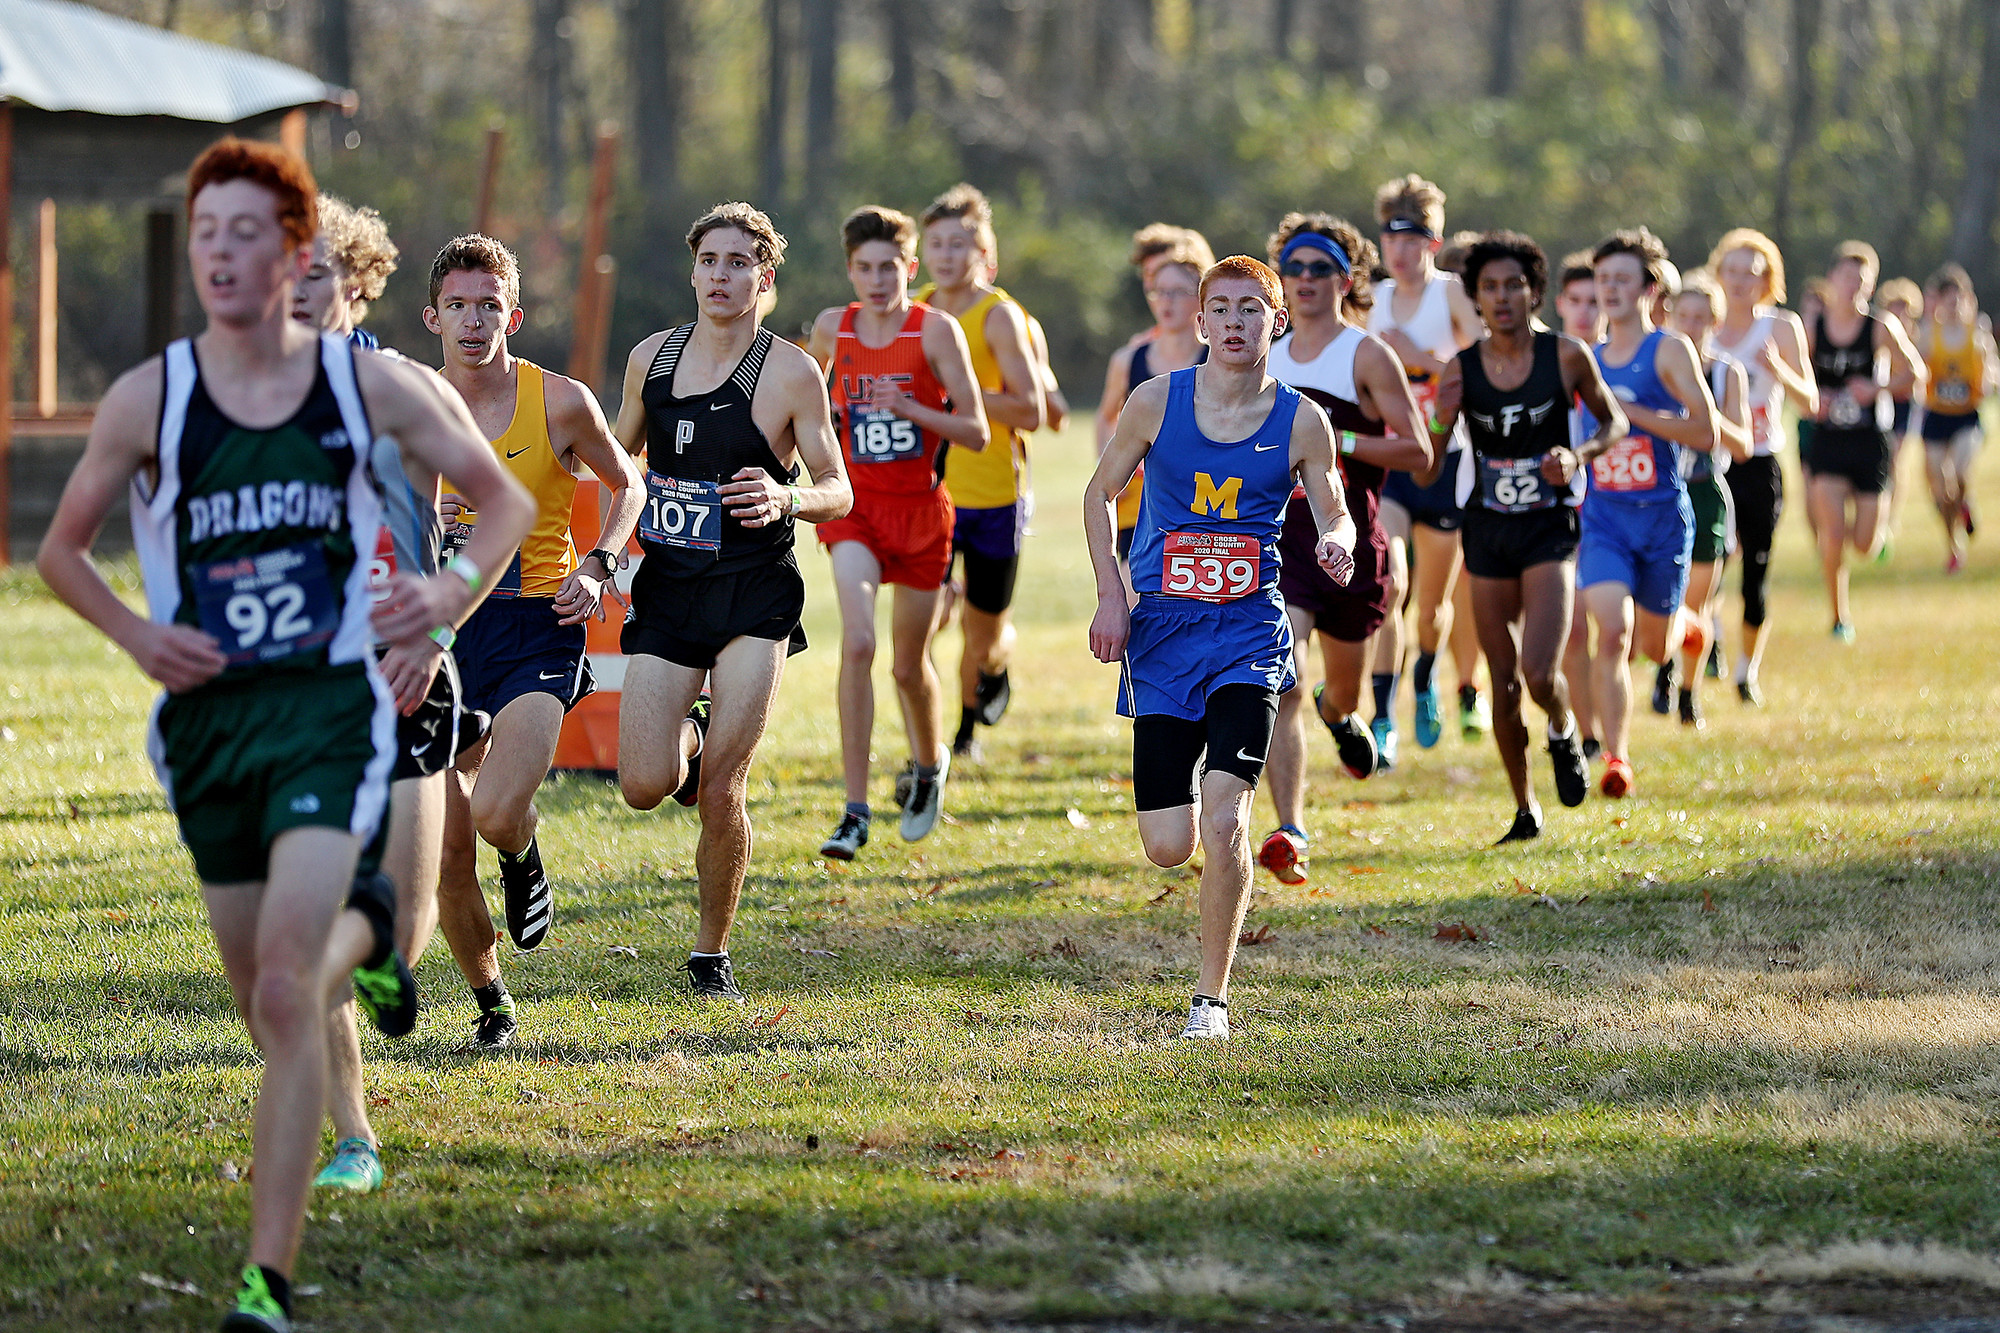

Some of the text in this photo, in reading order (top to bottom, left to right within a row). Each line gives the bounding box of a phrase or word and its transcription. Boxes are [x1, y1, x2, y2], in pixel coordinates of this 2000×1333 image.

[676, 420, 694, 454] P
[1501, 403, 1524, 437] F
[854, 420, 916, 455] 185
[678, 486, 708, 495] COUNTRY
[1190, 472, 1243, 519] M
[1495, 475, 1540, 505] 62
[650, 497, 710, 537] 107
[1213, 541, 1246, 549] COUNTRY
[1168, 557, 1254, 594] 539
[225, 582, 313, 650] 92
